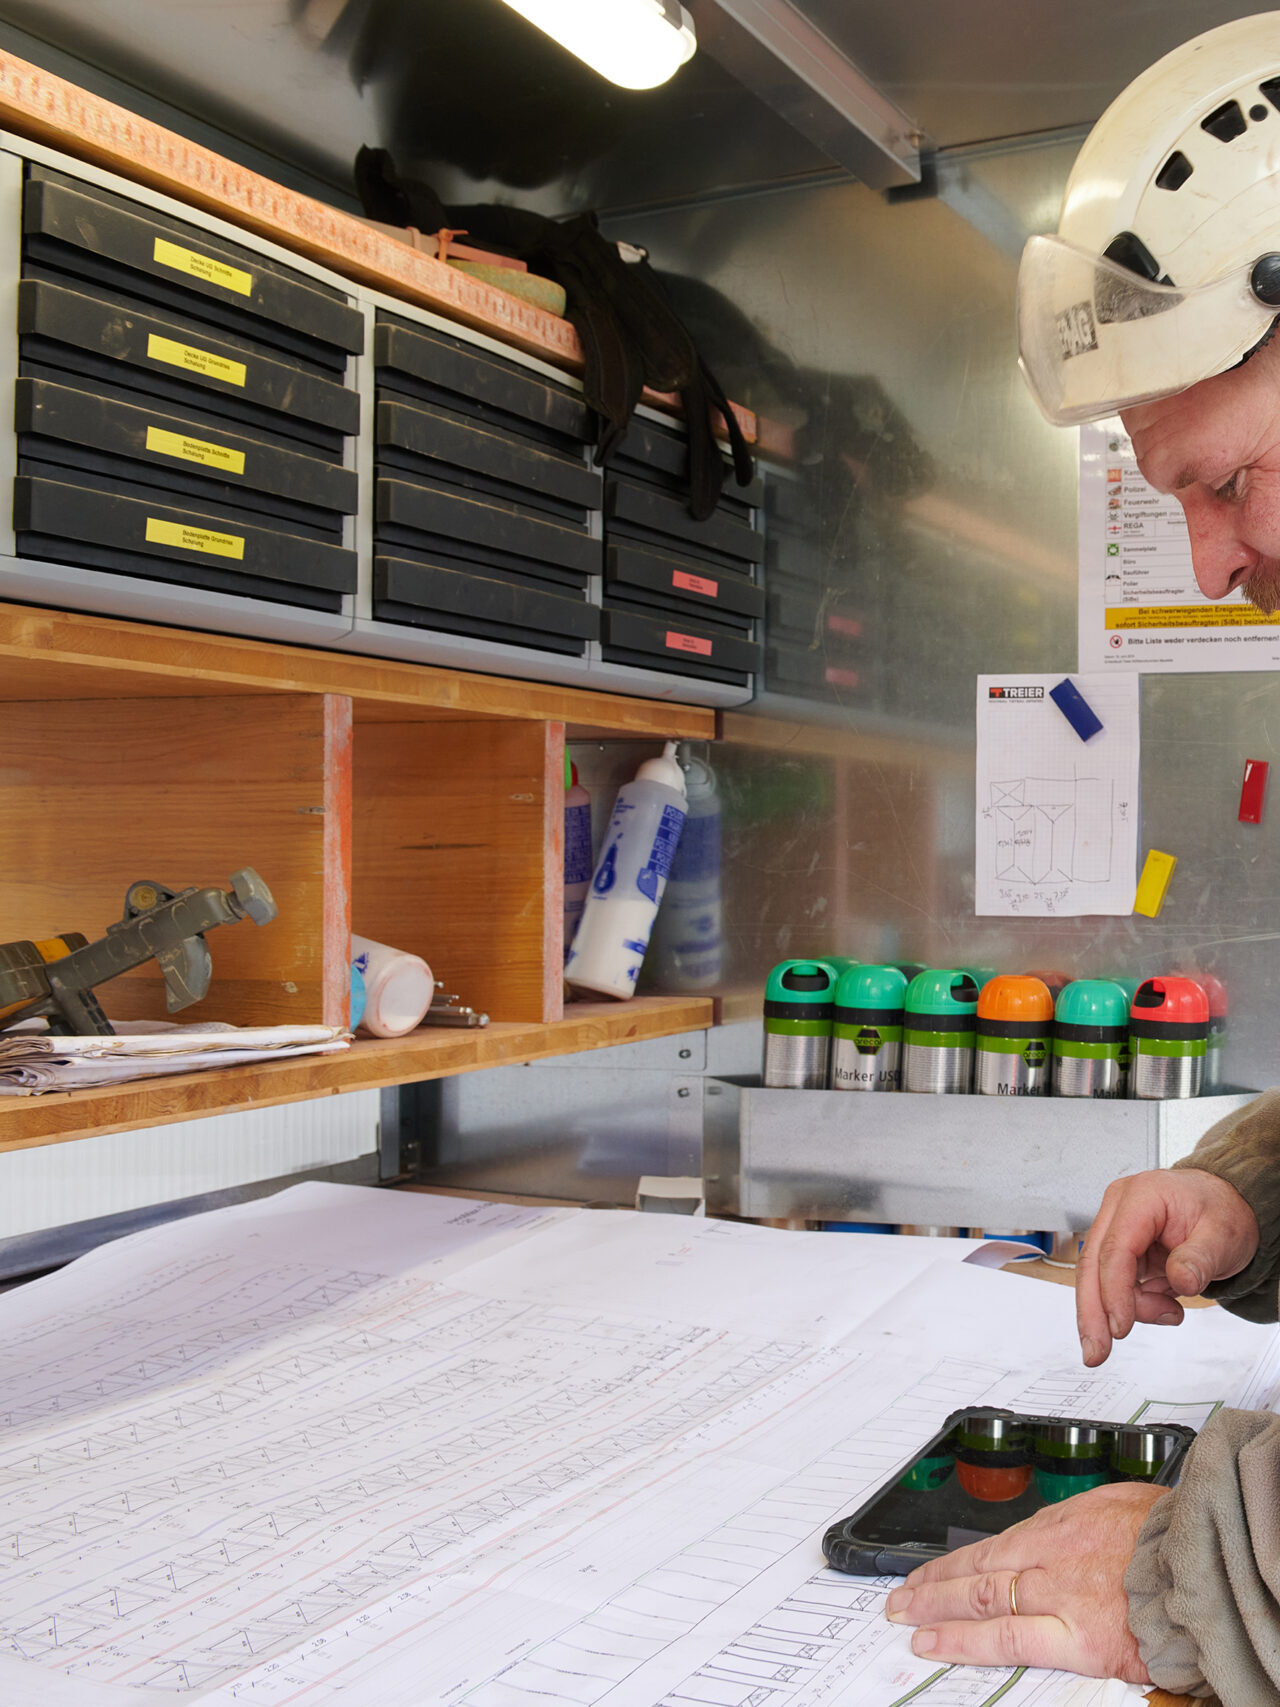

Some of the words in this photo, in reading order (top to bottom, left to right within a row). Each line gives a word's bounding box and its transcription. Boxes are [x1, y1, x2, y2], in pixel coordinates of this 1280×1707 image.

[182, 440, 211, 454] Bodenplatte
[182, 448, 205, 460] Schalung
[1123, 498, 1160, 506] Feuerwehr
[1123, 511, 1168, 519] Vergiftungen
[182, 529, 211, 541] Bodenplatte
[211, 535, 233, 546] Grundriss
[182, 537, 204, 548] Schalung
[1151, 607, 1213, 615] schwerwiegenden
[1115, 620, 1136, 628] sofort
[1137, 619, 1219, 627] Sicherheitsbeauftragten
[1145, 637, 1162, 645] Liste
[1164, 636, 1184, 644] weder
[1243, 634, 1280, 642] entfernen!
[1003, 688, 1043, 698] TREIER
[835, 1068, 875, 1082] Marker
[997, 1083, 1041, 1096] Marker
